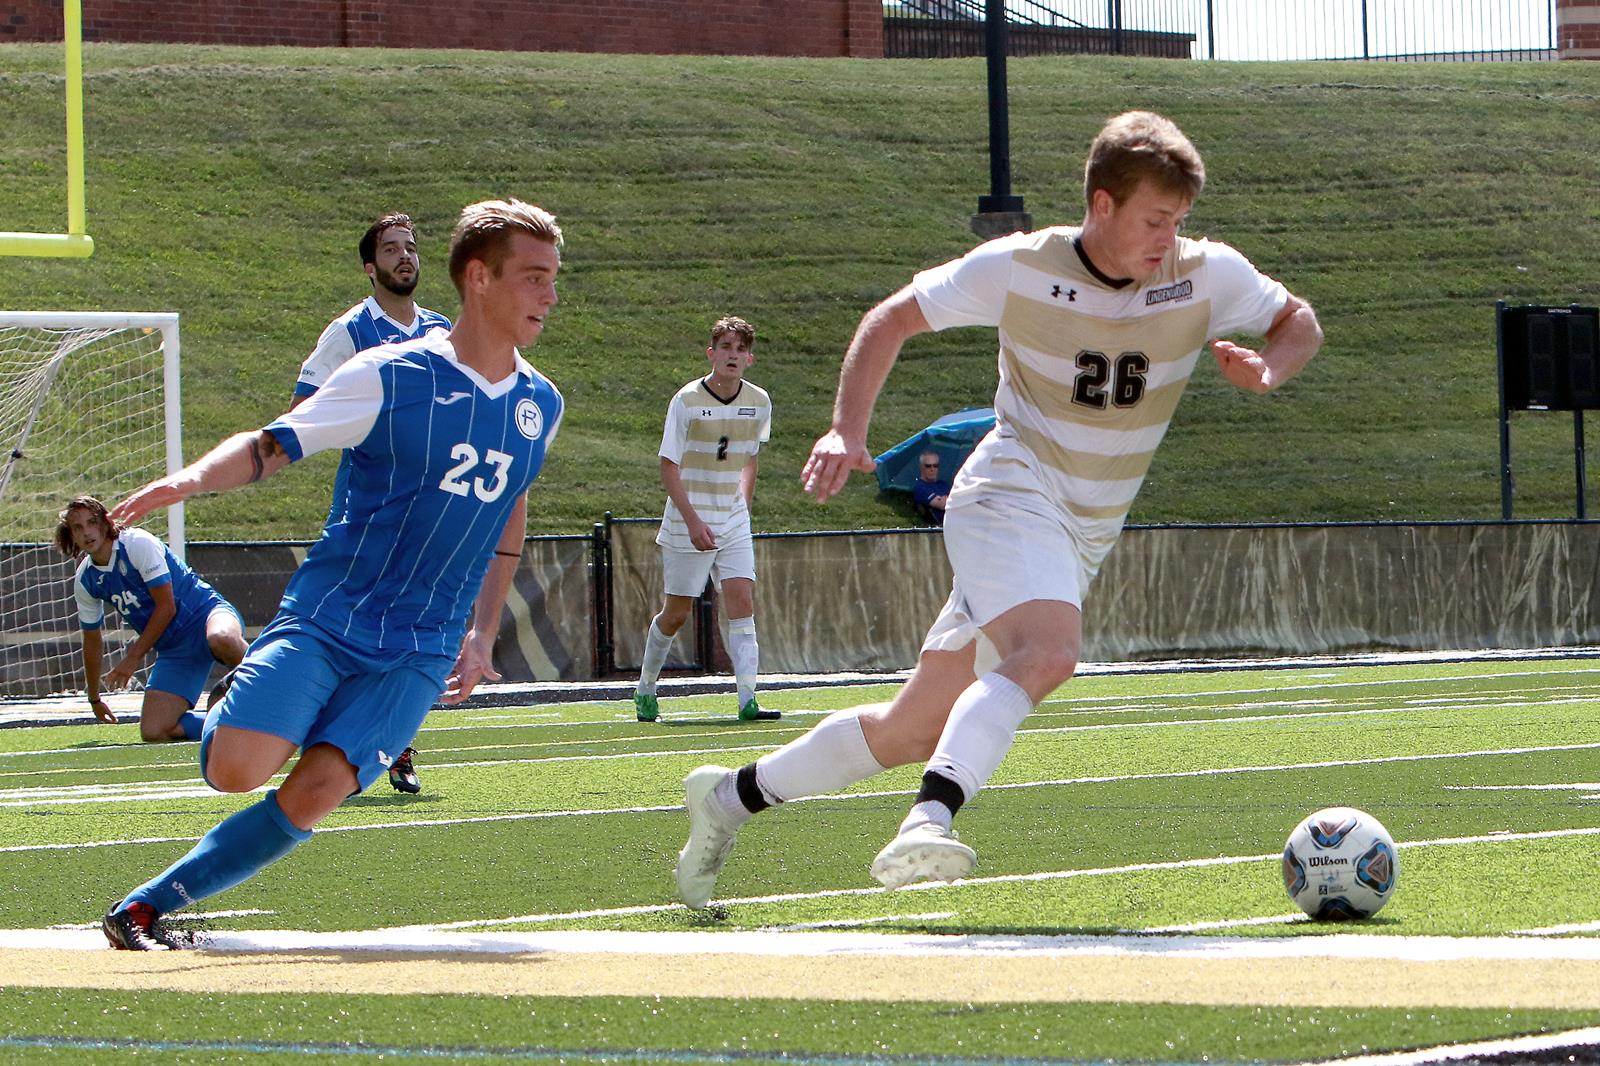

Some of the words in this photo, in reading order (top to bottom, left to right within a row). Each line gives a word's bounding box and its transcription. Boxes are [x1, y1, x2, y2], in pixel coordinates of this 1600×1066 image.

[1071, 350, 1150, 410] 26
[716, 436, 729, 461] 2
[439, 443, 514, 503] 23
[111, 590, 142, 616] 24
[1308, 855, 1348, 868] Wilson
